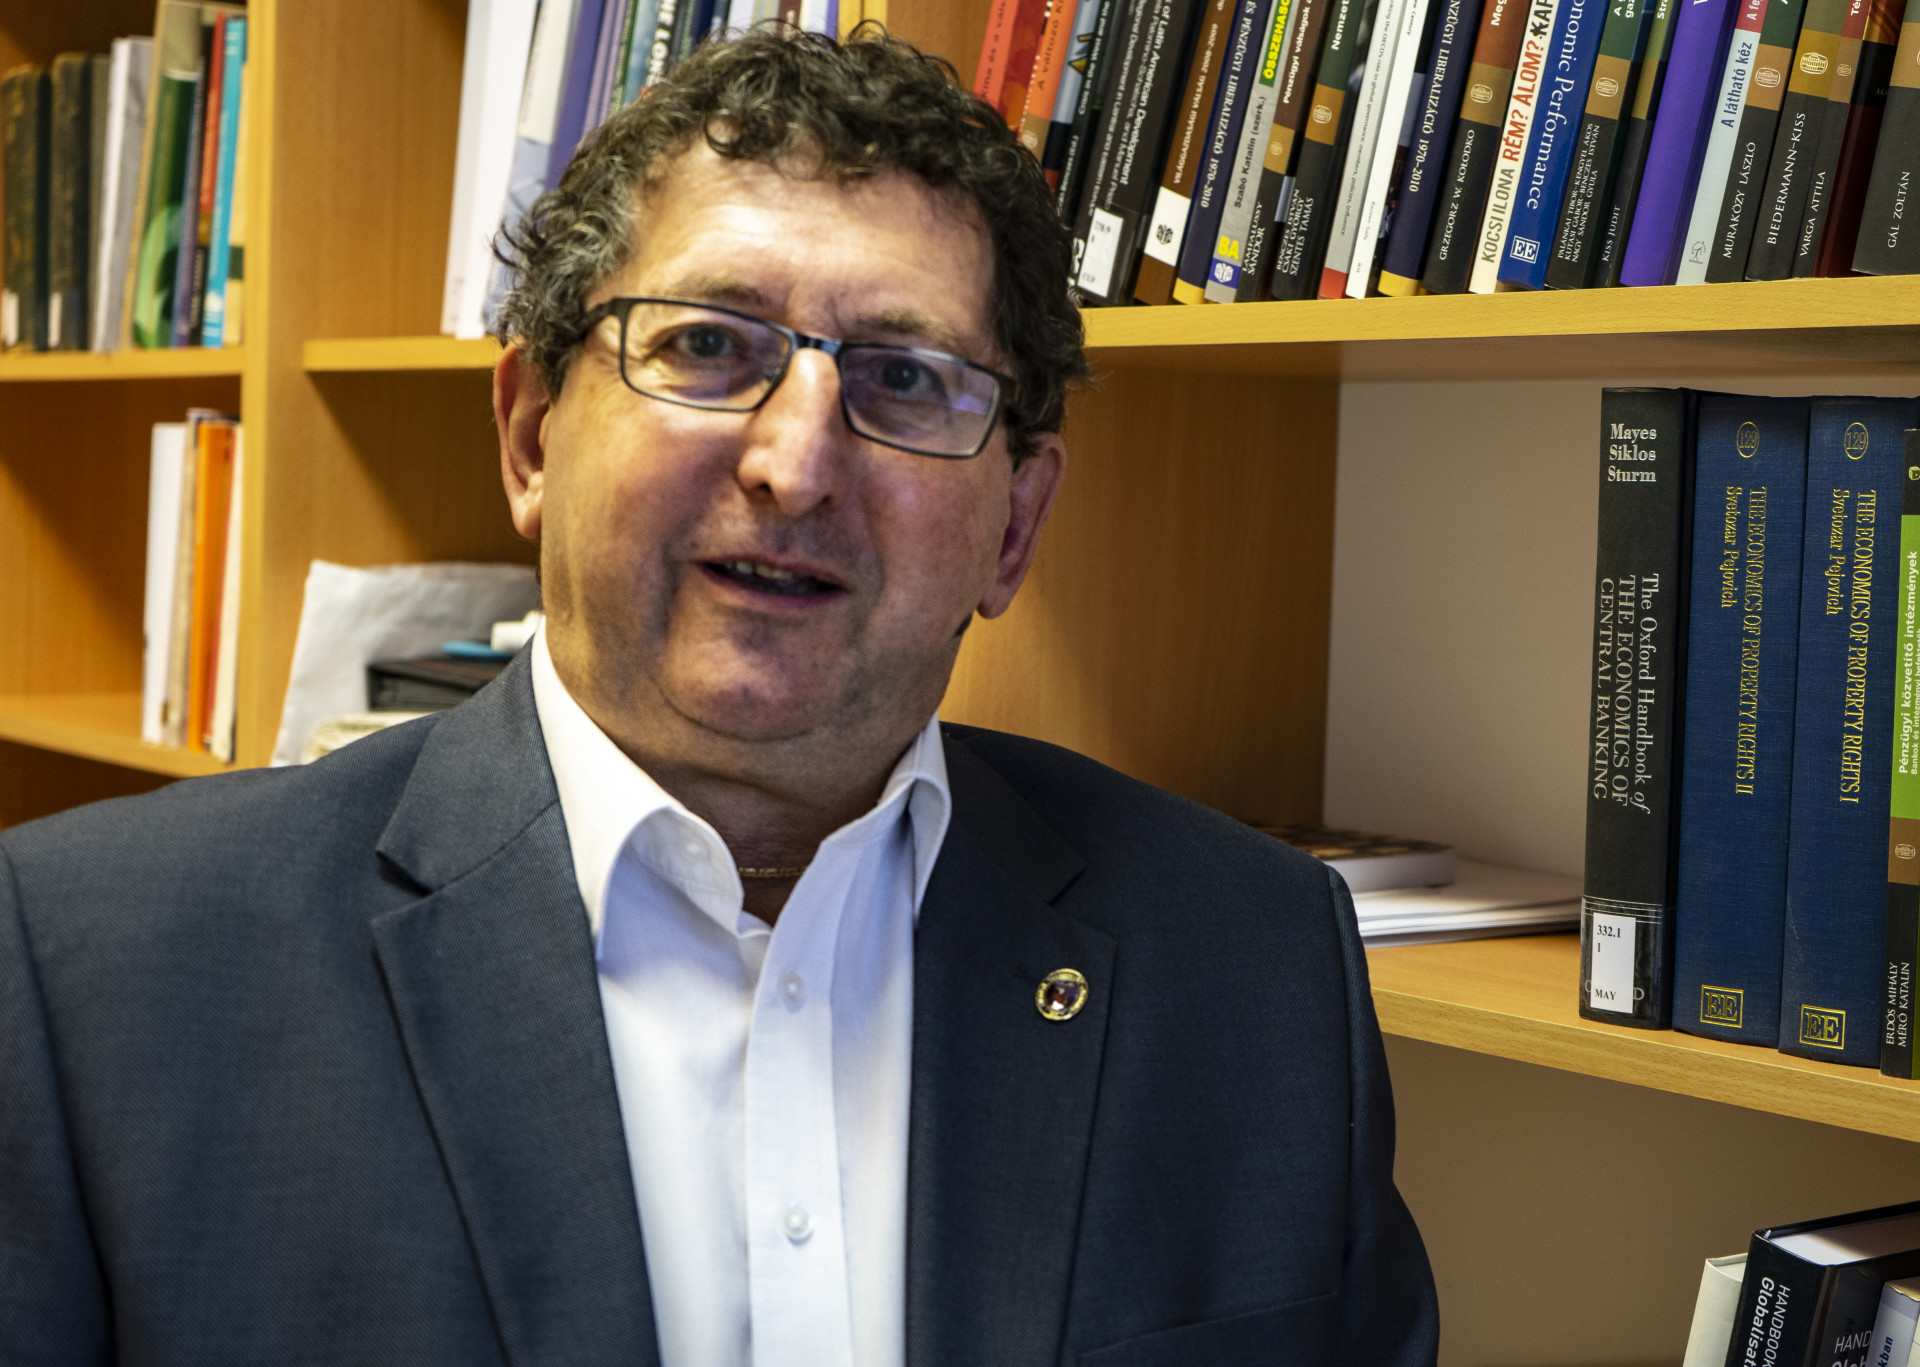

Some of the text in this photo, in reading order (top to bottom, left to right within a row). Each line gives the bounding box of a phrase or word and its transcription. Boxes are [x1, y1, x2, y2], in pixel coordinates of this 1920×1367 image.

[1154, 20, 1168, 49] Latin
[1162, 5, 1171, 20] of
[1613, 6, 1622, 17] A
[1746, 13, 1758, 21] A
[1850, 0, 1862, 16] Té
[1087, 61, 1096, 78] the
[1118, 34, 1139, 92] Development
[1231, 17, 1253, 72] PÉNZÜGYI
[1283, 55, 1300, 104] Pénzügyi
[1295, 6, 1311, 53] válságok
[1085, 79, 1092, 89] in
[1116, 91, 1124, 100] in
[1140, 50, 1160, 107] American
[1192, 74, 1206, 109] VÁLSÁG
[1422, 48, 1450, 135] LIBERALIZÁCIÓ
[1512, 40, 1544, 107] ÁLOM?
[1720, 42, 1753, 128] A látható kéz
[1213, 74, 1240, 155] LIBERALIZÁCIÓ
[1502, 108, 1529, 162] RÉM?
[1526, 75, 1575, 210] Performance
[1120, 108, 1147, 185] Development
[1233, 96, 1268, 209] Szabó Katalin (szerk.)
[1290, 198, 1305, 240] GYÖRGY
[1439, 129, 1475, 261] GRZEGORZ W. KOŁODKO
[1492, 168, 1515, 215] ILONA
[1557, 217, 1573, 259] PALÁNKAI
[1583, 123, 1593, 147] ÁKOS
[1564, 230, 1576, 261] KUTASI
[1587, 124, 1600, 156] ISTVÁN
[1571, 170, 1599, 263] NAGY SÁNDOR GYULA
[1722, 141, 1756, 259] MURAKÖZY LÁSZLÓ
[1800, 171, 1826, 257] VARGA ATTILA
[1887, 170, 1911, 248] GÁL ZOLTÁN
[1217, 235, 1239, 260] BA
[1247, 227, 1265, 276] SÁNDOR
[1290, 197, 1314, 276] SZENTES TAMÁS
[1481, 215, 1504, 264] KOCSI
[1511, 239, 1537, 261] EE
[1601, 205, 1621, 262] KISS JUDIT
[1609, 444, 1657, 462] Siklos
[1610, 423, 1657, 445] Mayes
[1738, 431, 1759, 450] 129
[1844, 432, 1868, 452] 129
[1607, 465, 1657, 482] Sturm
[1856, 489, 1877, 523] THE
[1719, 486, 1743, 608] Svetozar Pejovich
[1825, 489, 1850, 615] Svetozar Pejovich
[1850, 526, 1875, 619] ECONOMICS
[1735, 486, 1768, 795] THE ECONOMICS OF PROPERTY RIGHTS II
[1849, 621, 1870, 645] OF
[1593, 577, 1615, 801] CENTRAL BANKING
[1843, 646, 1869, 732] PROPERTY
[1898, 550, 1920, 774] Pénzügyi közvetítő intézmények
[1611, 575, 1636, 808] THE ECONOMICS OF
[1630, 573, 1660, 814] The Oxford Handbook of
[1840, 733, 1863, 793] RIGHTS
[1910, 747, 1919, 775] Bankok
[1913, 732, 1920, 741] és
[1596, 924, 1621, 939] 332.1
[1595, 988, 1617, 1001] MAY
[1704, 993, 1738, 1022] EE
[1885, 962, 1898, 1045] ERDŐS MIHÁLY
[1896, 962, 1910, 1047] MÉRŐ KATALIN
[1804, 1011, 1840, 1042] EE
[1743, 1276, 1775, 1367] Globalisat
[1761, 1284, 1791, 1367] HANDBOOK
